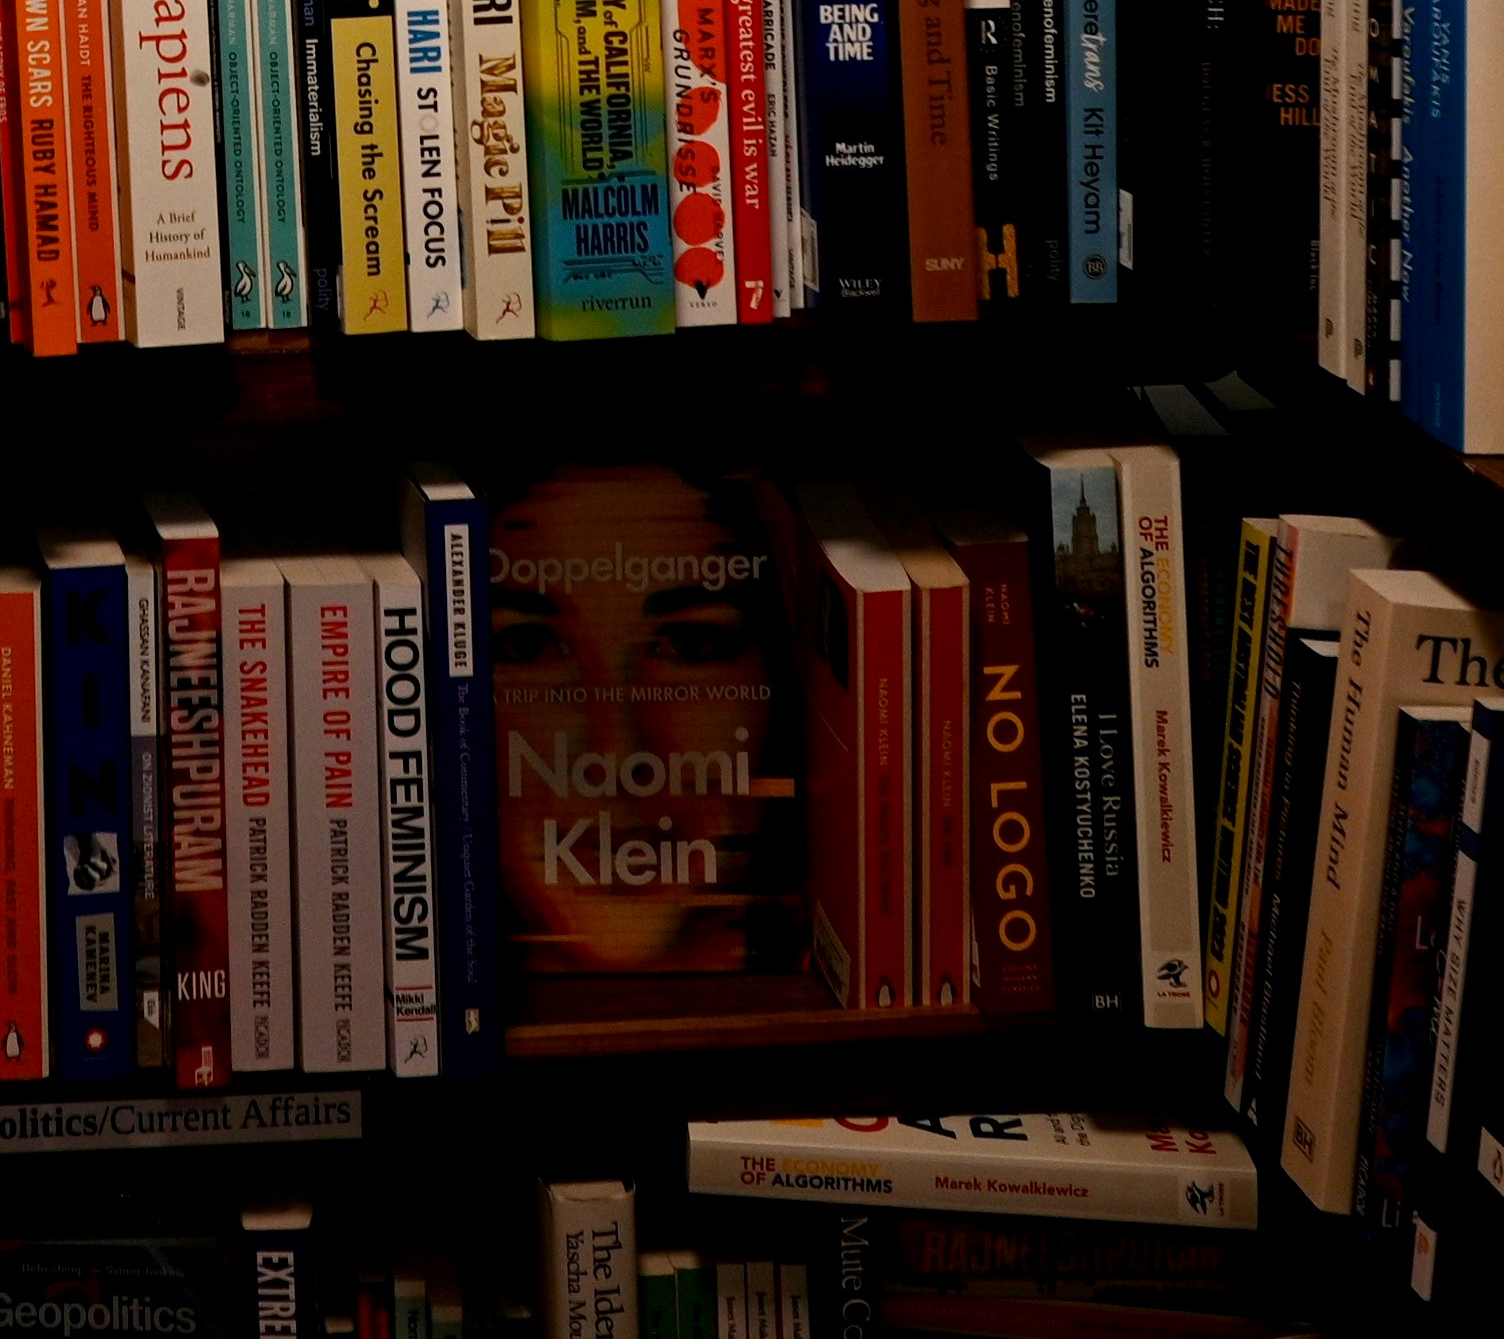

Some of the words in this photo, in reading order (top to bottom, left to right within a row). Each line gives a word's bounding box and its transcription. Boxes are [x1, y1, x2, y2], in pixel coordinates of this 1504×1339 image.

[819, 4, 879, 25] BEING
[825, 42, 874, 63] TIME
[354, 41, 378, 138] Chasing
[360, 143, 380, 179] the
[361, 184, 382, 277] Scream
[320, 604, 350, 701] EMPIRE
[382, 605, 421, 736] HOOD
[324, 711, 352, 744] OF
[983, 665, 1024, 752] NO
[326, 753, 353, 809] PAIN
[507, 726, 751, 798] Naomi
[389, 746, 431, 962] FEMINISM
[543, 817, 719, 886] Klein
[990, 785, 1038, 951] LOGO
[240, 1098, 351, 1132] Affairs
[934, 1175, 982, 1193] Marek
[986, 1177, 1090, 1198] Kowalkiewicz
